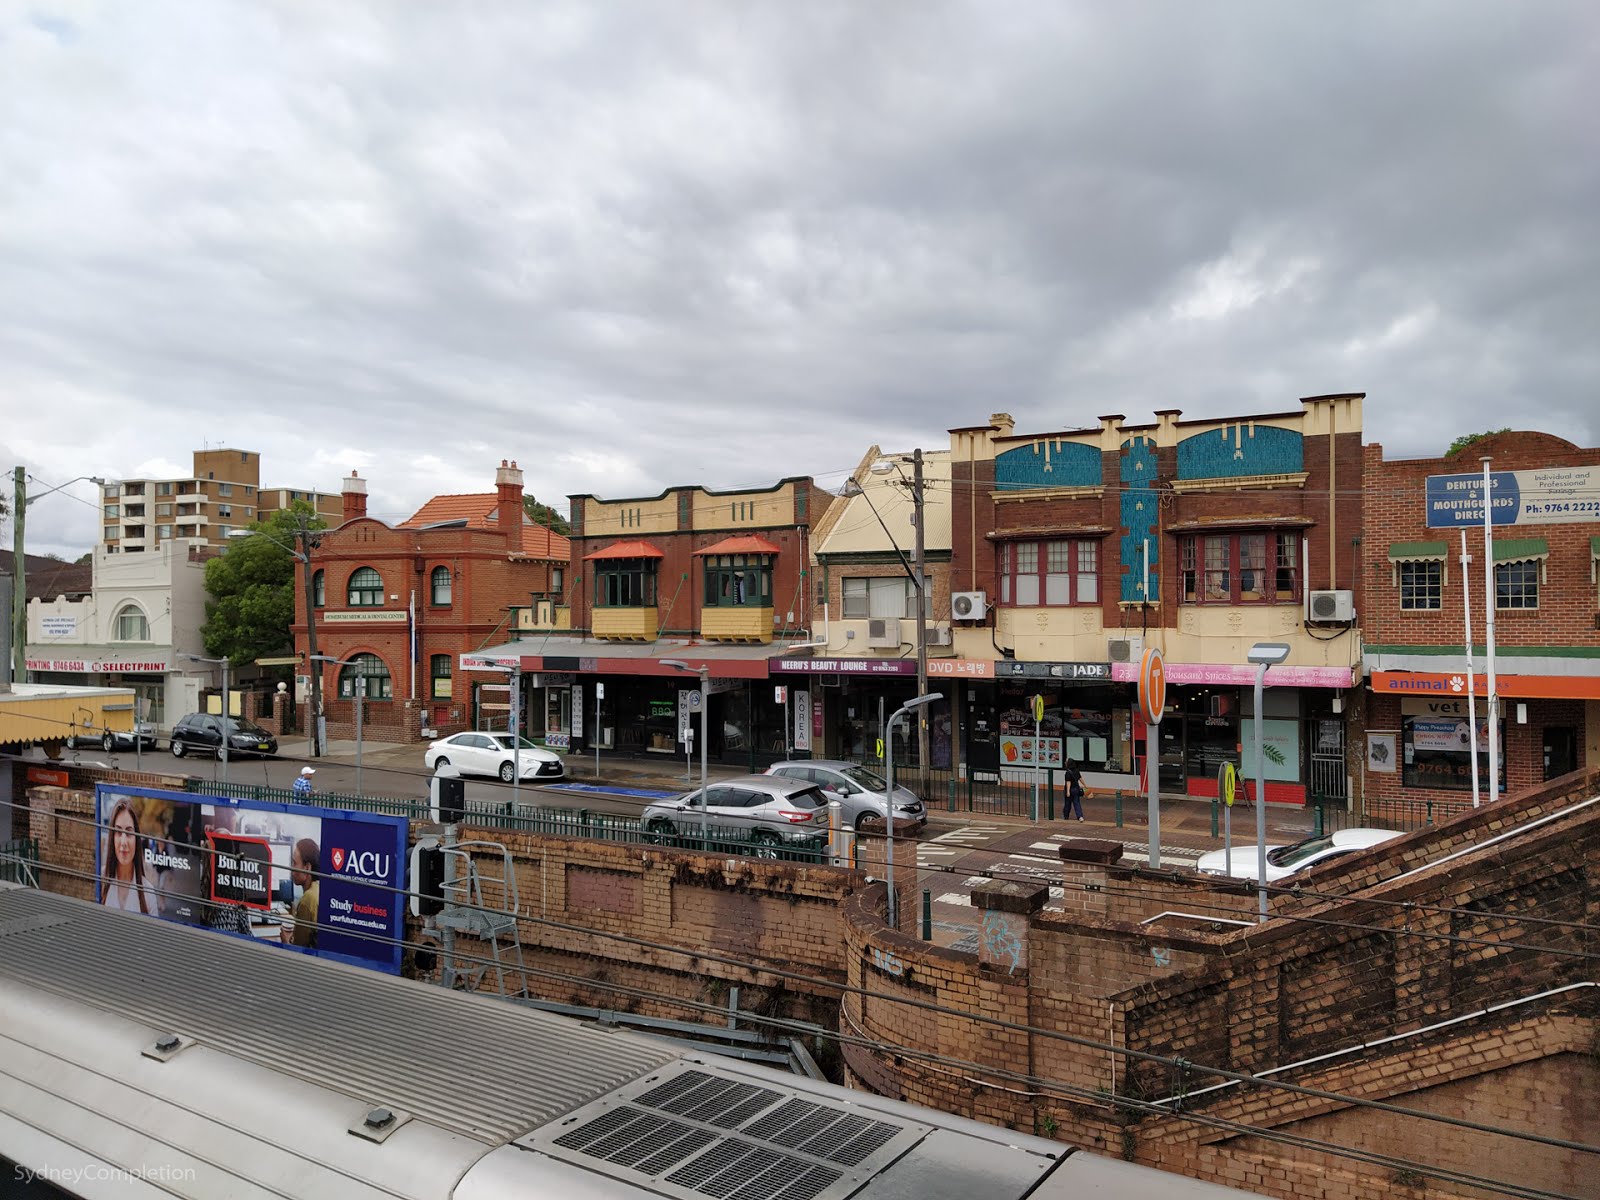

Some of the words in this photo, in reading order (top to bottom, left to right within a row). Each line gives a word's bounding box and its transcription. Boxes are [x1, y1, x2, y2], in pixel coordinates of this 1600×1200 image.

[1534, 473, 1572, 481] Individual
[1574, 471, 1590, 479] and
[1446, 479, 1498, 490] DENTURES
[1539, 479, 1586, 488] Professional
[1469, 489, 1477, 498] &
[1433, 498, 1514, 510] MOUTHGURDS
[1525, 505, 1542, 513] Ph:
[1544, 503, 1570, 513] 9764
[1572, 502, 1600, 511] 2222
[1455, 510, 1487, 520] DIREC
[103, 662, 166, 671] SELECTPRINT
[781, 661, 808, 670] NEERU'S
[811, 661, 838, 670] BEAUTY
[840, 661, 867, 671] LOUNGE
[928, 662, 953, 673] DVD
[957, 663, 986, 675] 노래방
[1073, 665, 1103, 677] JADE
[1205, 671, 1231, 681] Spices
[1389, 678, 1447, 690] animal
[1428, 701, 1460, 713] vet
[1417, 763, 1452, 775] 9764
[144, 848, 192, 871] Business.
[345, 851, 390, 879] ACU
[239, 859, 260, 874] not
[217, 873, 231, 886] as
[231, 875, 266, 893] usual.
[329, 897, 353, 914] Study
[353, 902, 387, 917] business
